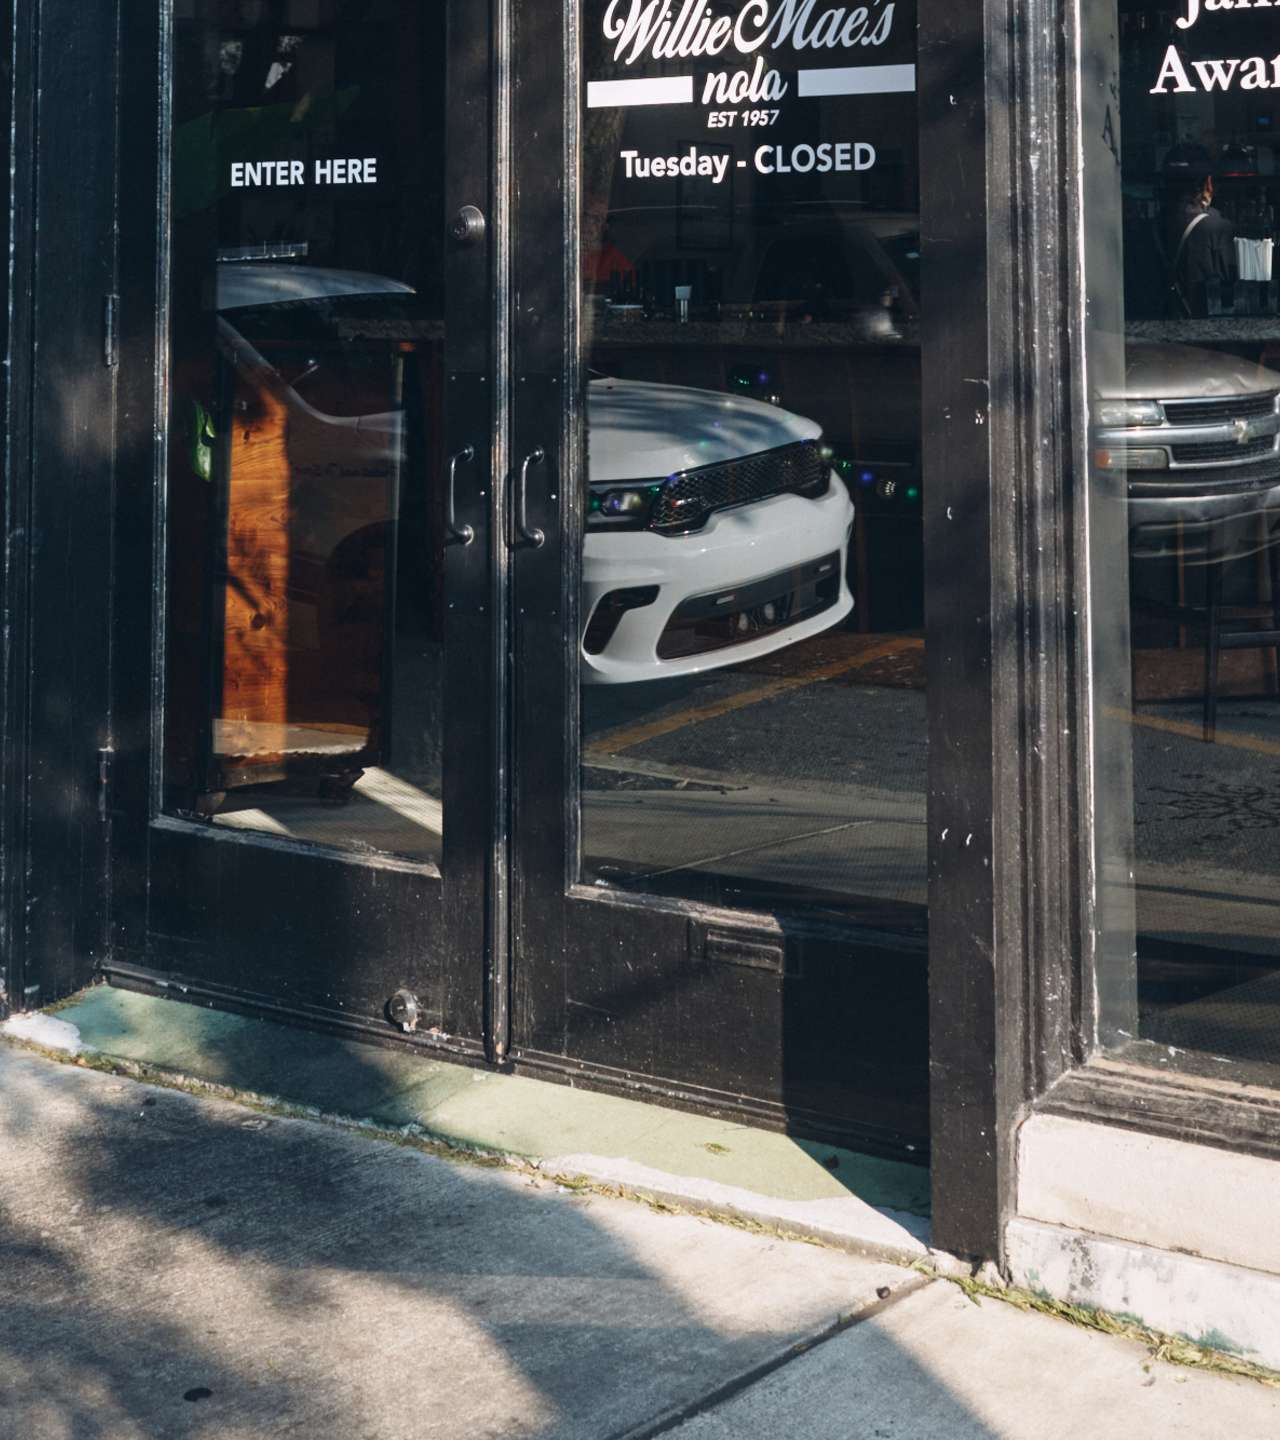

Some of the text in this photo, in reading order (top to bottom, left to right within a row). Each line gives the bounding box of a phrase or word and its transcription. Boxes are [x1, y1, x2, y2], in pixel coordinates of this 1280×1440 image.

[702, 56, 788, 105] nola
[707, 109, 780, 128] EST 1957
[231, 158, 377, 187] ENTER HERE
[621, 146, 729, 183] Tuesday
[754, 142, 876, 174] CLOSED
